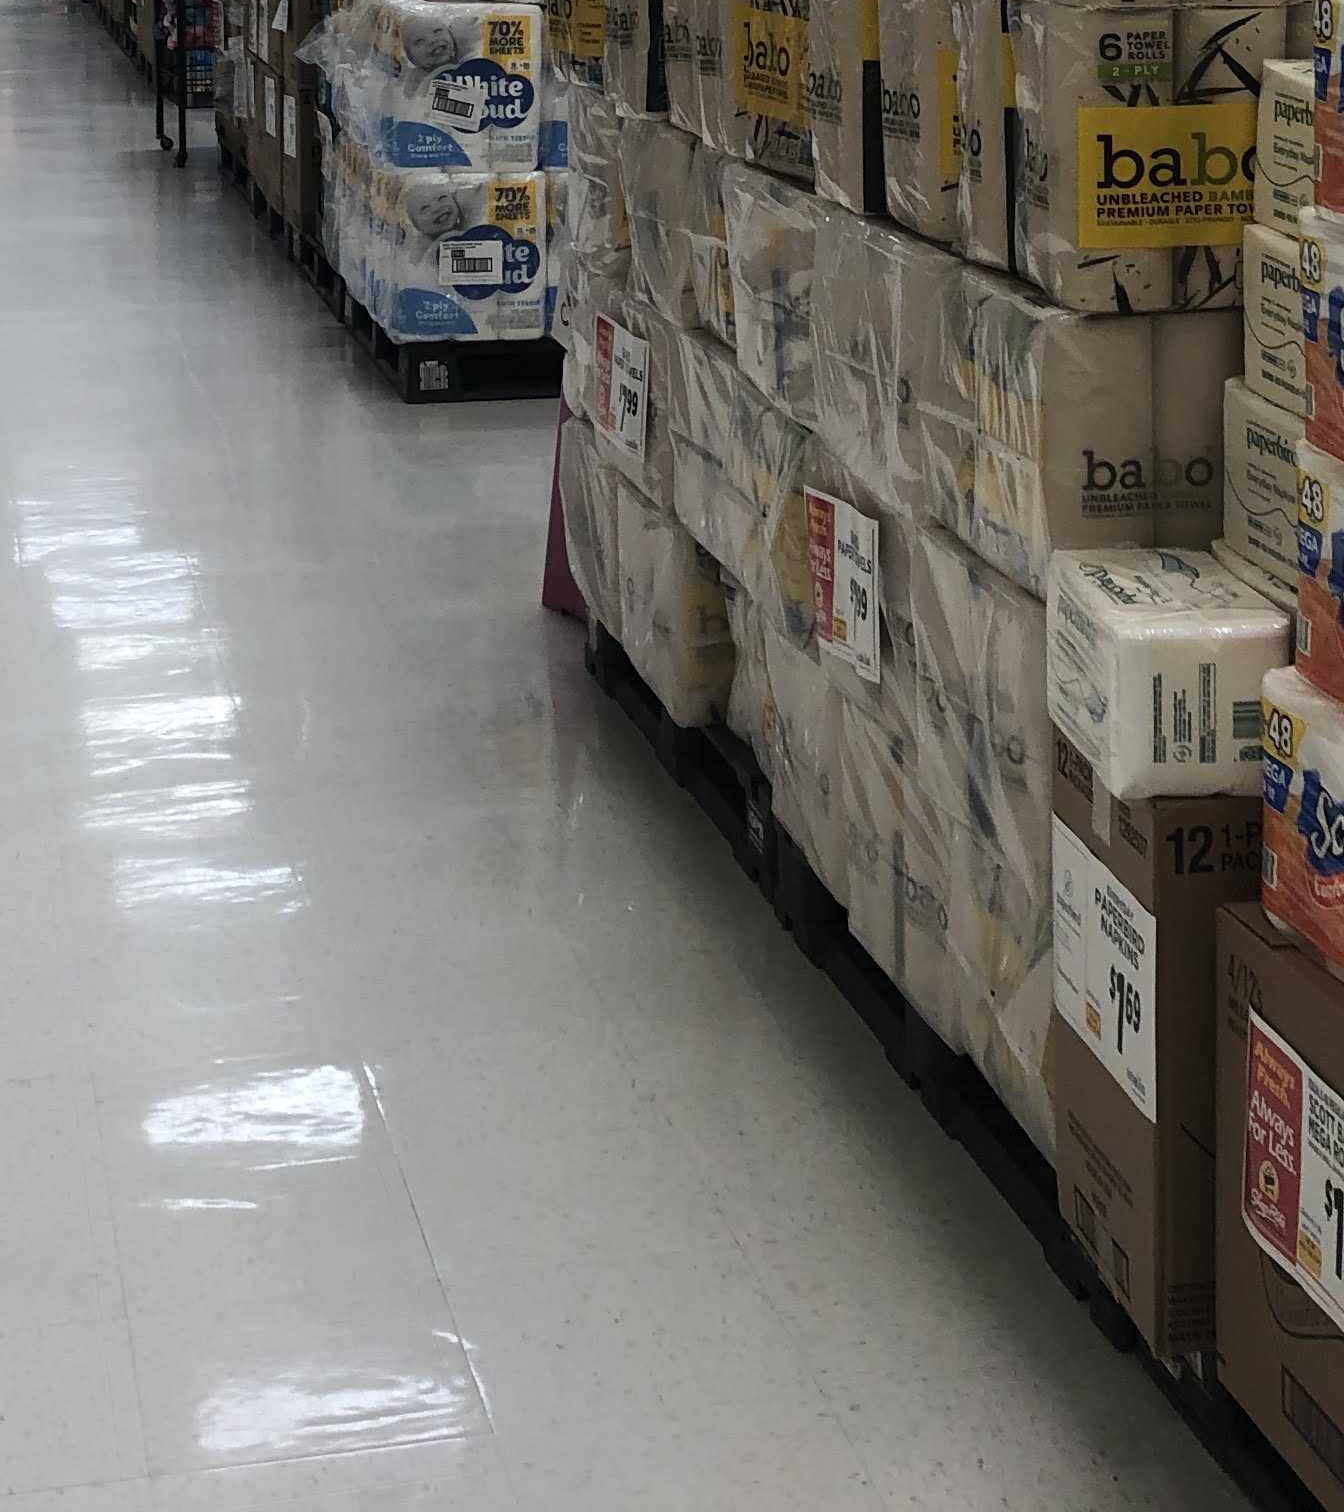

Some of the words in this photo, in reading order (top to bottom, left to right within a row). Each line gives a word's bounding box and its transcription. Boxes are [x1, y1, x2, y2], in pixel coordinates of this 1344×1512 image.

[488, 20, 525, 37] 70%
[1126, 30, 1166, 41] PAPER
[488, 37, 524, 47] MORE
[1099, 33, 1123, 61] 6
[1126, 41, 1171, 50] TOWEL
[1127, 50, 1166, 61] ROLLS
[1096, 132, 1256, 189] bab
[494, 186, 531, 203] 70%
[1096, 191, 1203, 206] UNBLEACHED
[495, 202, 530, 213] MORE
[1096, 205, 1170, 218] PREMIUM
[1175, 203, 1223, 217] PAPER
[1299, 241, 1322, 279] 48
[1081, 449, 1214, 491] babo
[1081, 502, 1134, 513] PREMIUM
[1300, 480, 1324, 521] 48
[1267, 710, 1294, 757] 48
[1166, 825, 1215, 876] 12
[1100, 915, 1140, 972] NAPKINS
[1250, 1088, 1295, 1148] Always
[1308, 1092, 1335, 1130] SCOTT
